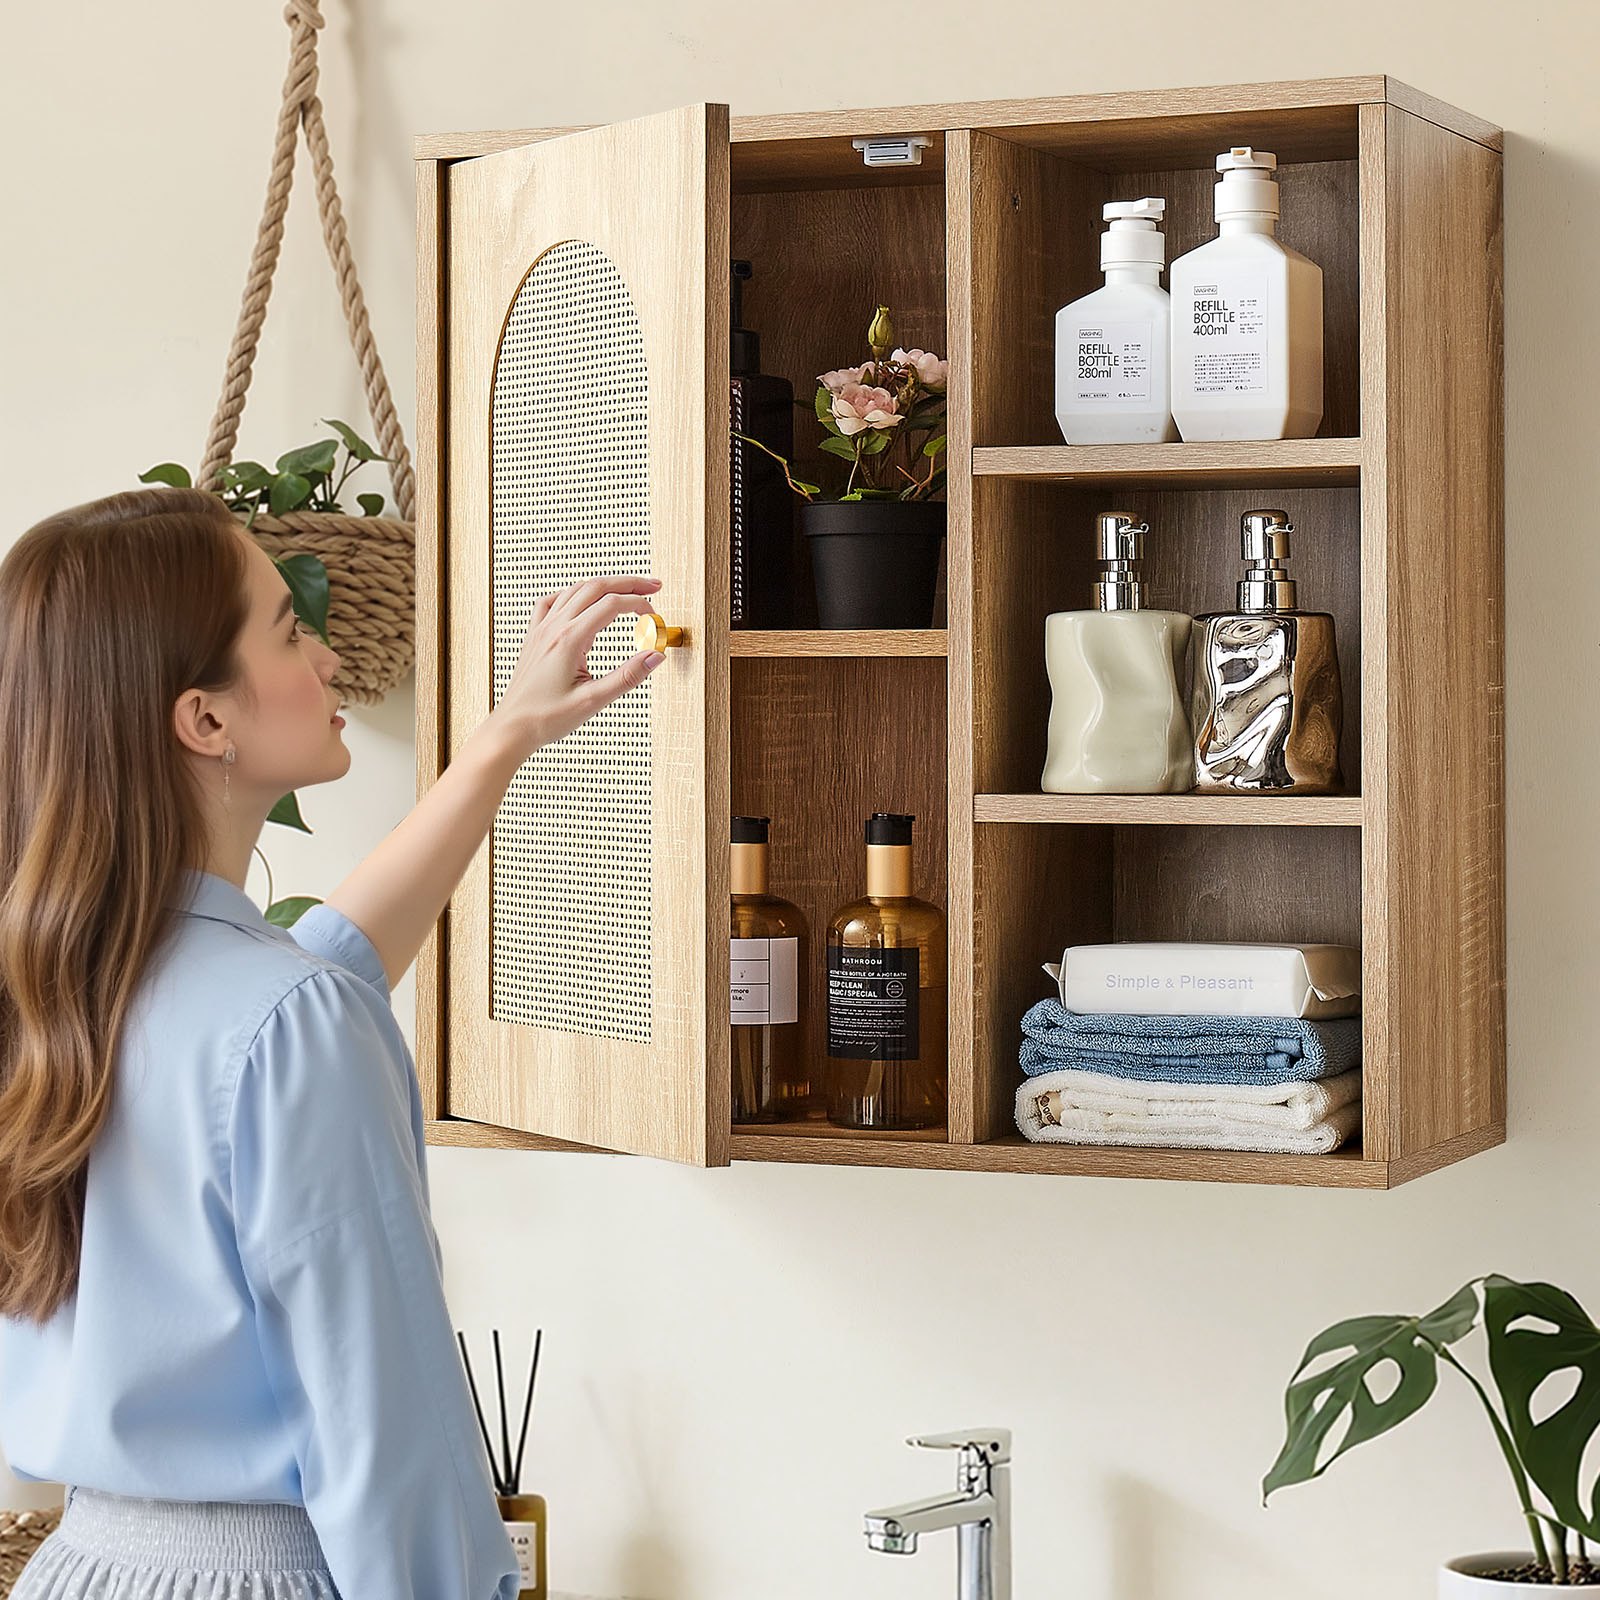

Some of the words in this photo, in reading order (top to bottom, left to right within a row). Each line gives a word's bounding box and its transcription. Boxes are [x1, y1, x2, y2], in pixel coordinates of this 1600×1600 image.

[1194, 300, 1228, 311] REFILL
[1194, 311, 1235, 324] BOTTLE
[1193, 324, 1228, 336] 400ml
[1079, 344, 1113, 354] REFILL
[1078, 355, 1119, 367] BOTTLE
[1078, 367, 1112, 378] 280ml
[841, 981, 863, 989] CLEAN
[1106, 974, 1160, 991] Simple
[1165, 977, 1175, 989] &
[1180, 975, 1255, 990] Pleasant
